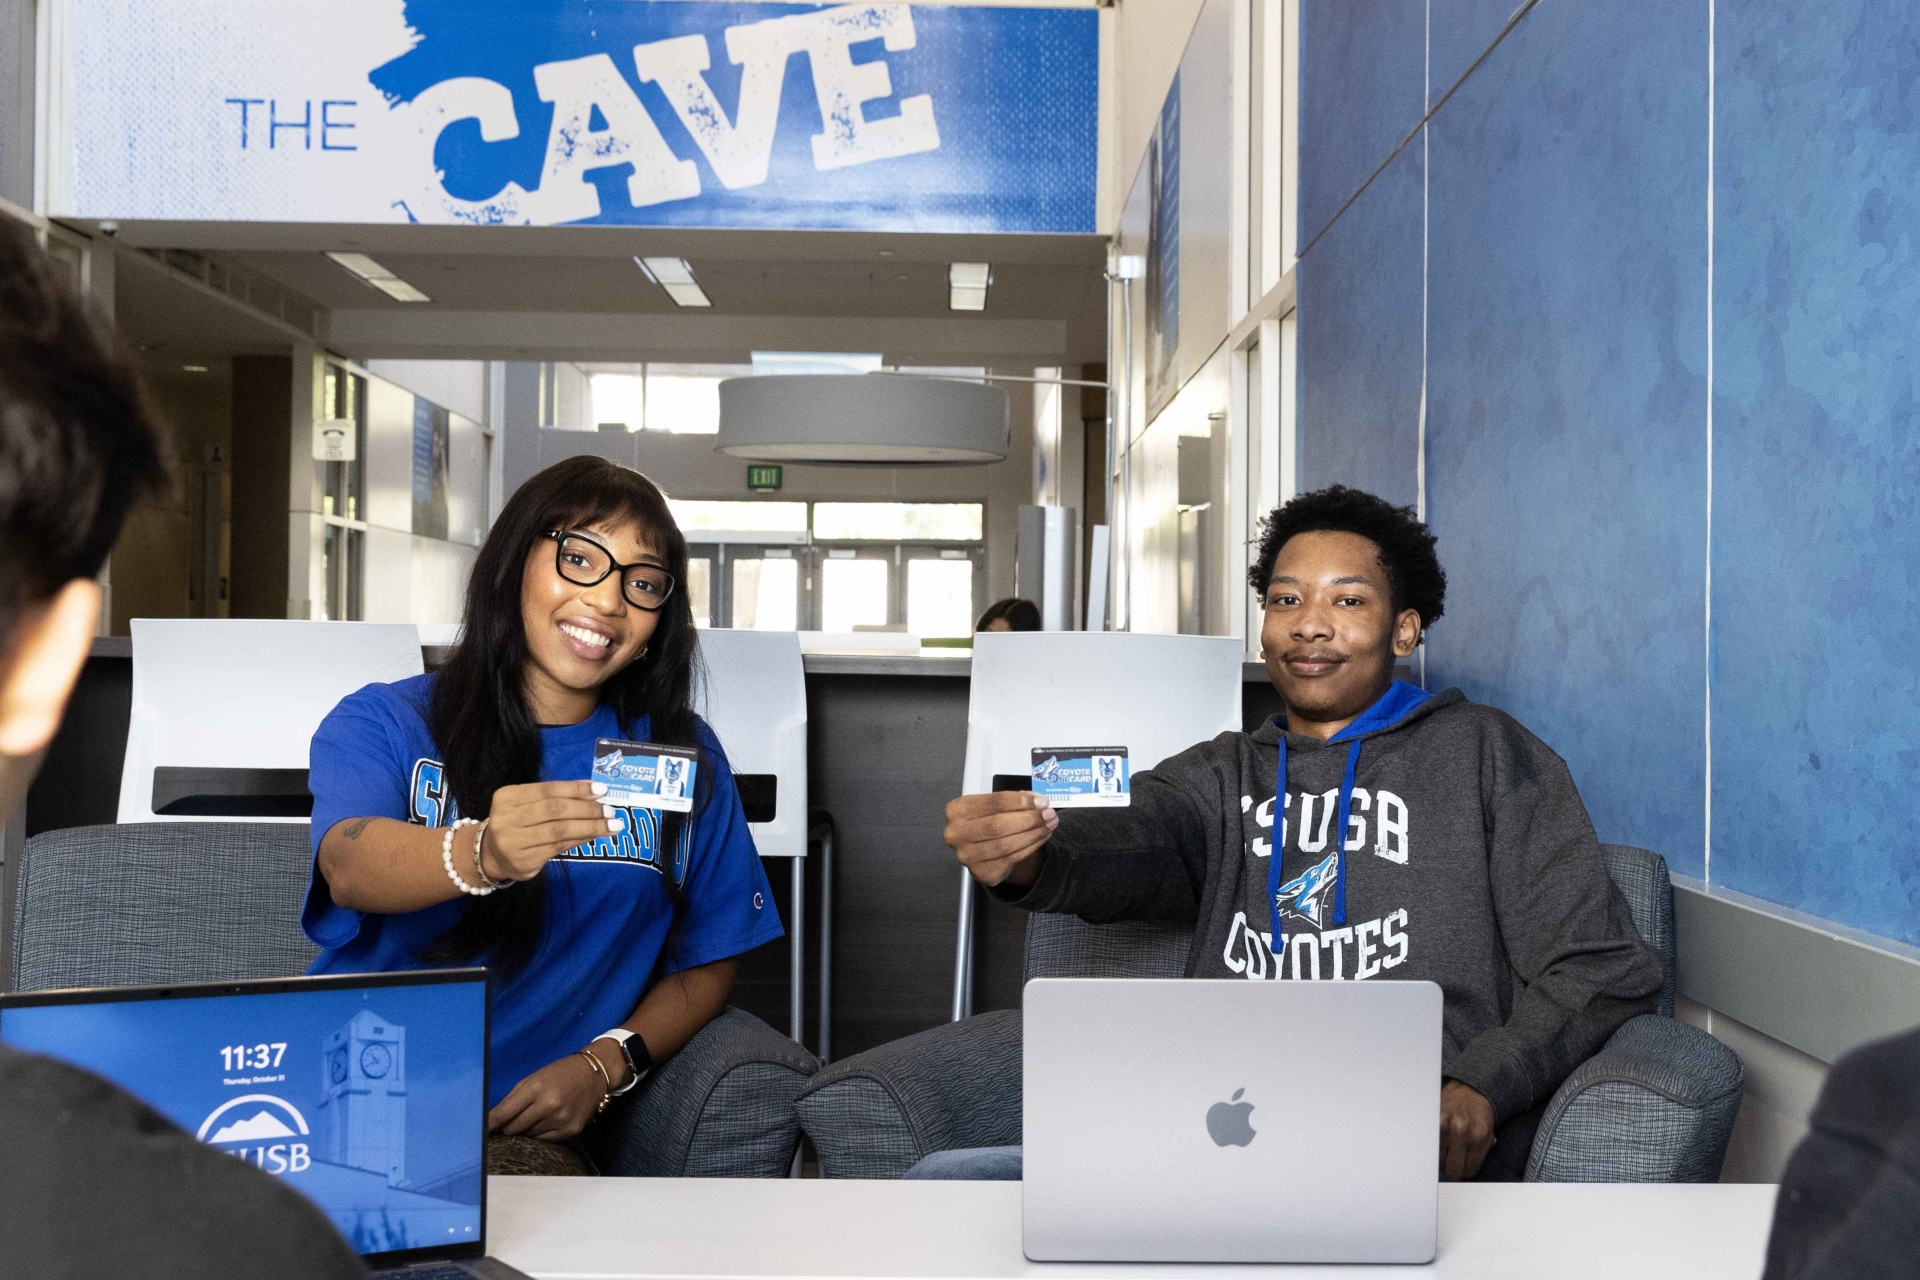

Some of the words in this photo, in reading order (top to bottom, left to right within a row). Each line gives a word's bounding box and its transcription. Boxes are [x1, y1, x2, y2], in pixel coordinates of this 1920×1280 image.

[224, 96, 358, 153] THE
[401, 3, 941, 227] CAVE
[753, 468, 777, 485] EXIT
[620, 764, 656, 774] COYOTE
[1058, 768, 1091, 776] COYOTE
[220, 1042, 288, 1071] 11:37
[223, 1077, 252, 1086] Thursday,
[252, 1075, 277, 1083] October
